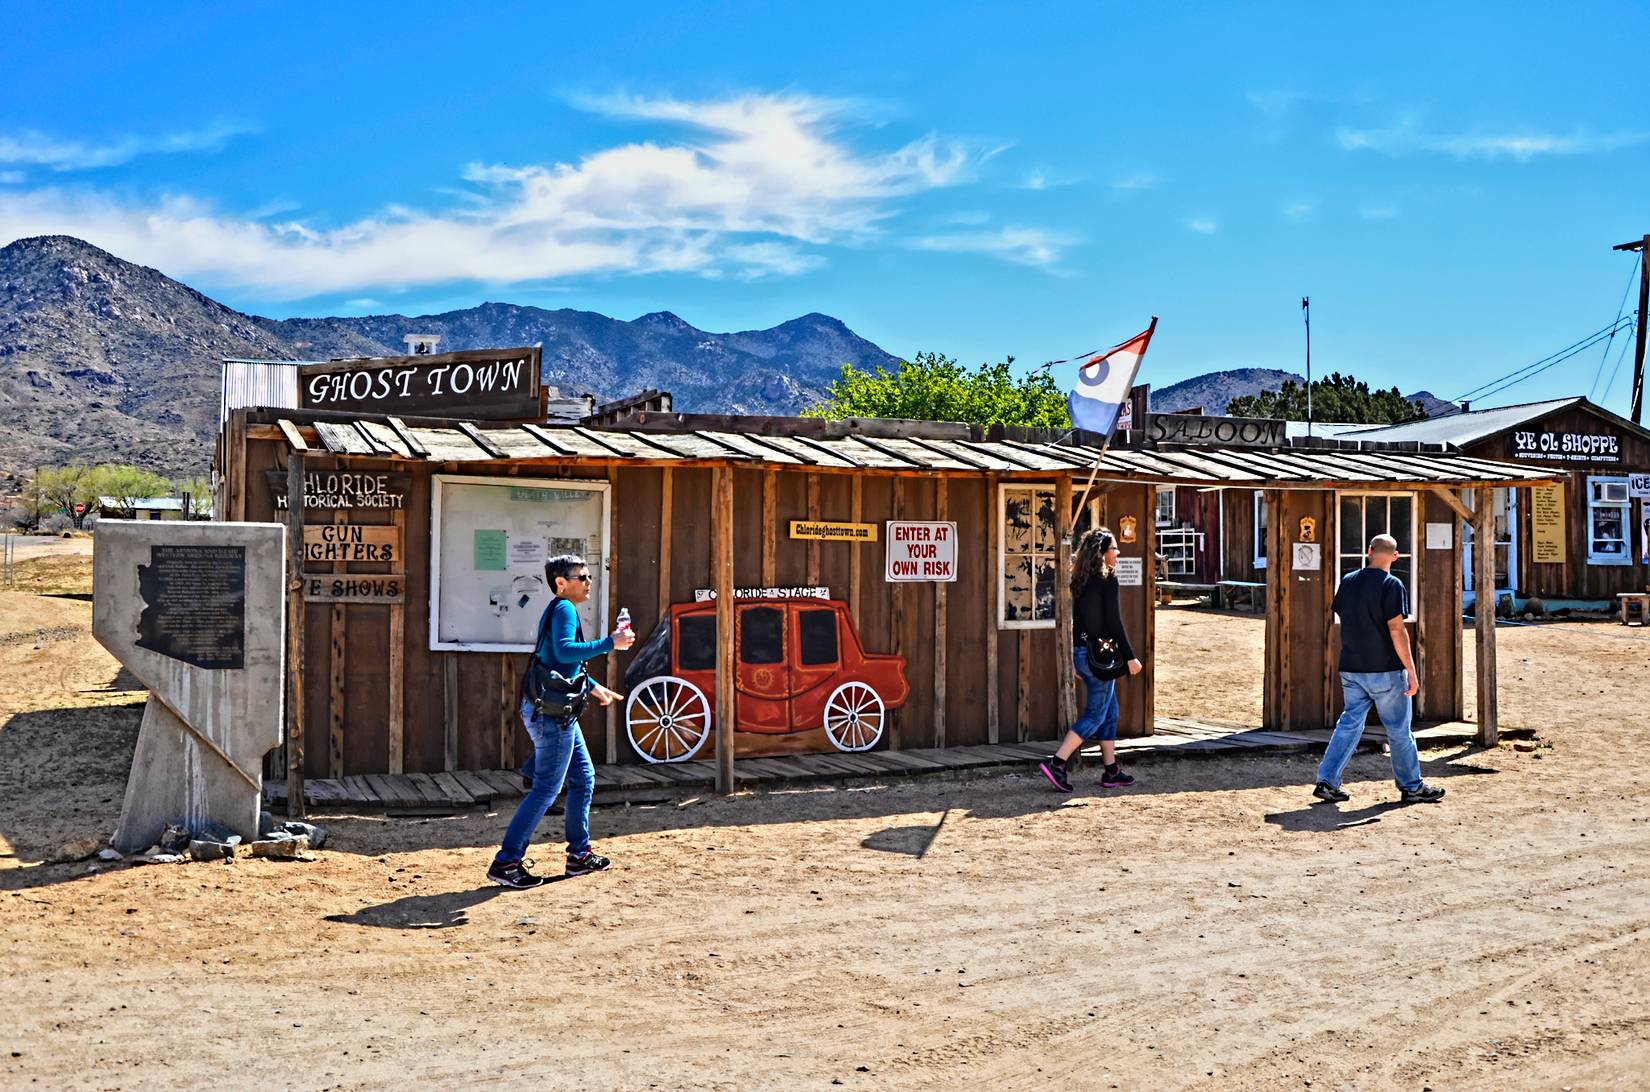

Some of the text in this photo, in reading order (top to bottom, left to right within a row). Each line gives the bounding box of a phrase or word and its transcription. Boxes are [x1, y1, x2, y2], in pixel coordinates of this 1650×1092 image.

[309, 359, 525, 403] GHOST TOWN
[1148, 415, 1283, 445] SALOON
[1515, 432, 1537, 450] YE
[1562, 434, 1618, 454] SHOPPE
[304, 472, 388, 494] HLORIDE
[1631, 476, 1650, 489] ICE
[277, 494, 404, 508] HTORICAL SOCIETY
[322, 526, 362, 542] GUN
[796, 524, 868, 538] Chlorideghosttown.com
[895, 527, 948, 541] ENTER AT
[304, 543, 393, 560] IGHTERS
[907, 544, 937, 558] YOUR
[893, 561, 950, 575] OWN RISK
[331, 579, 399, 597] SHOWS
[709, 587, 816, 600] CORIDE STAGE
